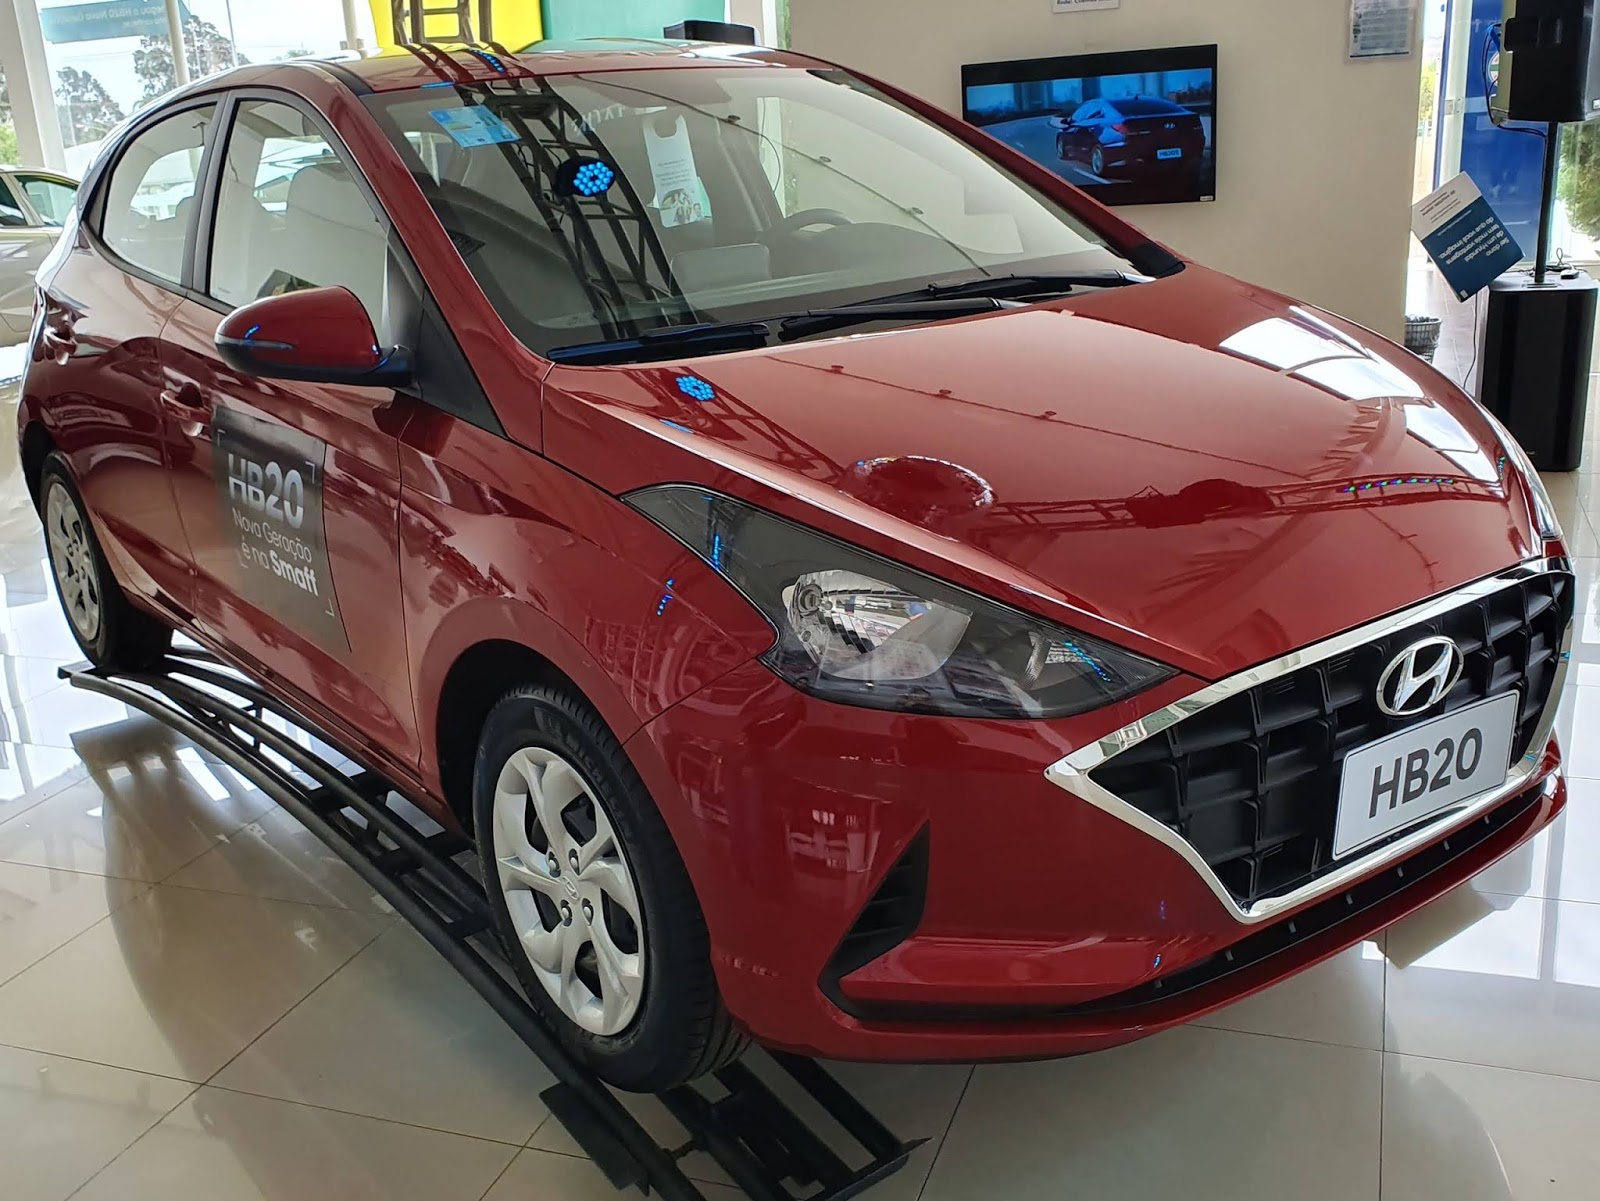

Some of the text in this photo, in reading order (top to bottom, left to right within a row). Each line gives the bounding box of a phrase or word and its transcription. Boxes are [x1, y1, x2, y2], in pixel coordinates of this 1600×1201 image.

[1475, 222, 1487, 232] que
[1485, 216, 1494, 225] do
[1445, 223, 1500, 265] tem mais vantagens
[1464, 230, 1504, 262] de um Hyundai
[1485, 243, 1500, 257] dono
[228, 453, 305, 529] HB20
[232, 507, 313, 563] Nova Geração
[253, 546, 269, 570] na
[269, 549, 319, 597] Smaff
[1368, 727, 1483, 819] HB20
